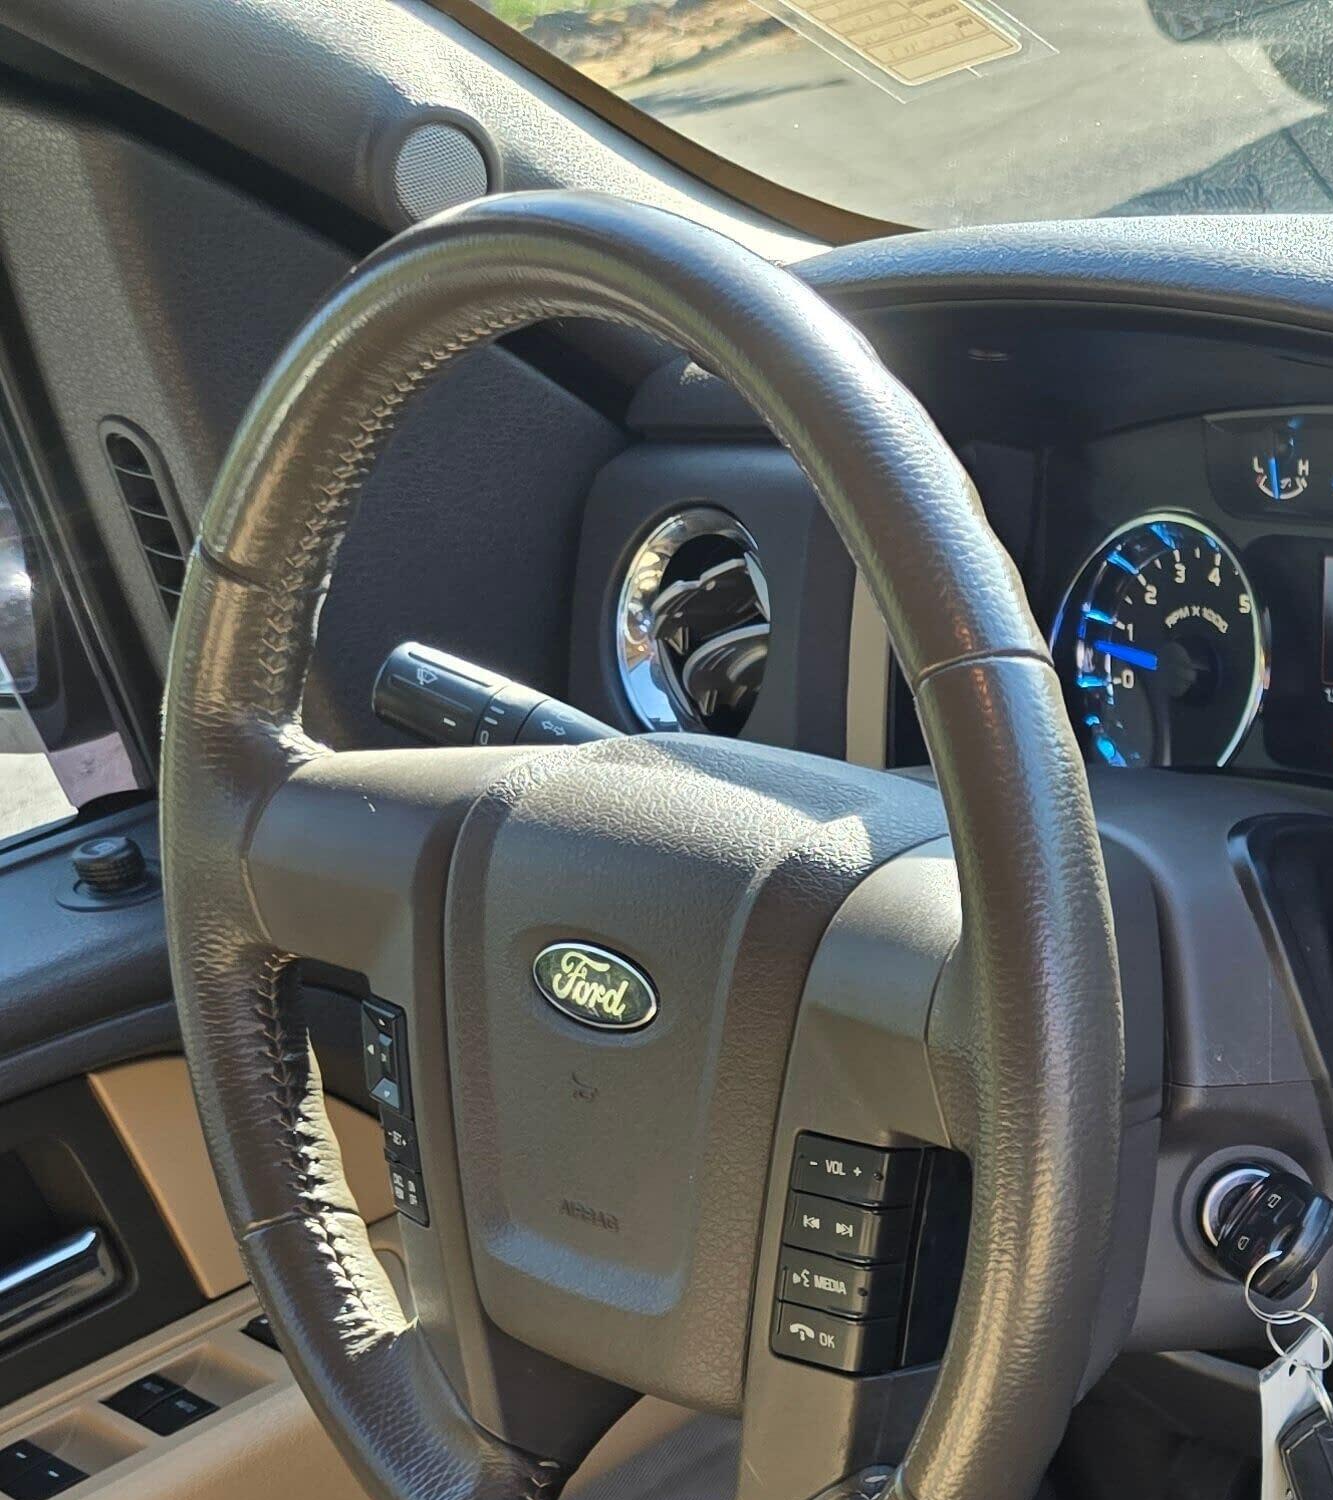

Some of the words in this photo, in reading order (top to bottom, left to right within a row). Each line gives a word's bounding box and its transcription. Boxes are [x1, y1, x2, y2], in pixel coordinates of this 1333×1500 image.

[1298, 459, 1308, 475] H
[1174, 562, 1186, 583] 3
[1208, 567, 1221, 587] 4
[1144, 584, 1157, 605] 2
[1238, 593, 1251, 614] 5
[1126, 623, 1134, 642] 1
[1121, 669, 1135, 689] 0
[552, 950, 630, 1017] Ford
[825, 1159, 847, 1176] VOL
[813, 1274, 848, 1296] MEDIA
[818, 1331, 836, 1349] OK
